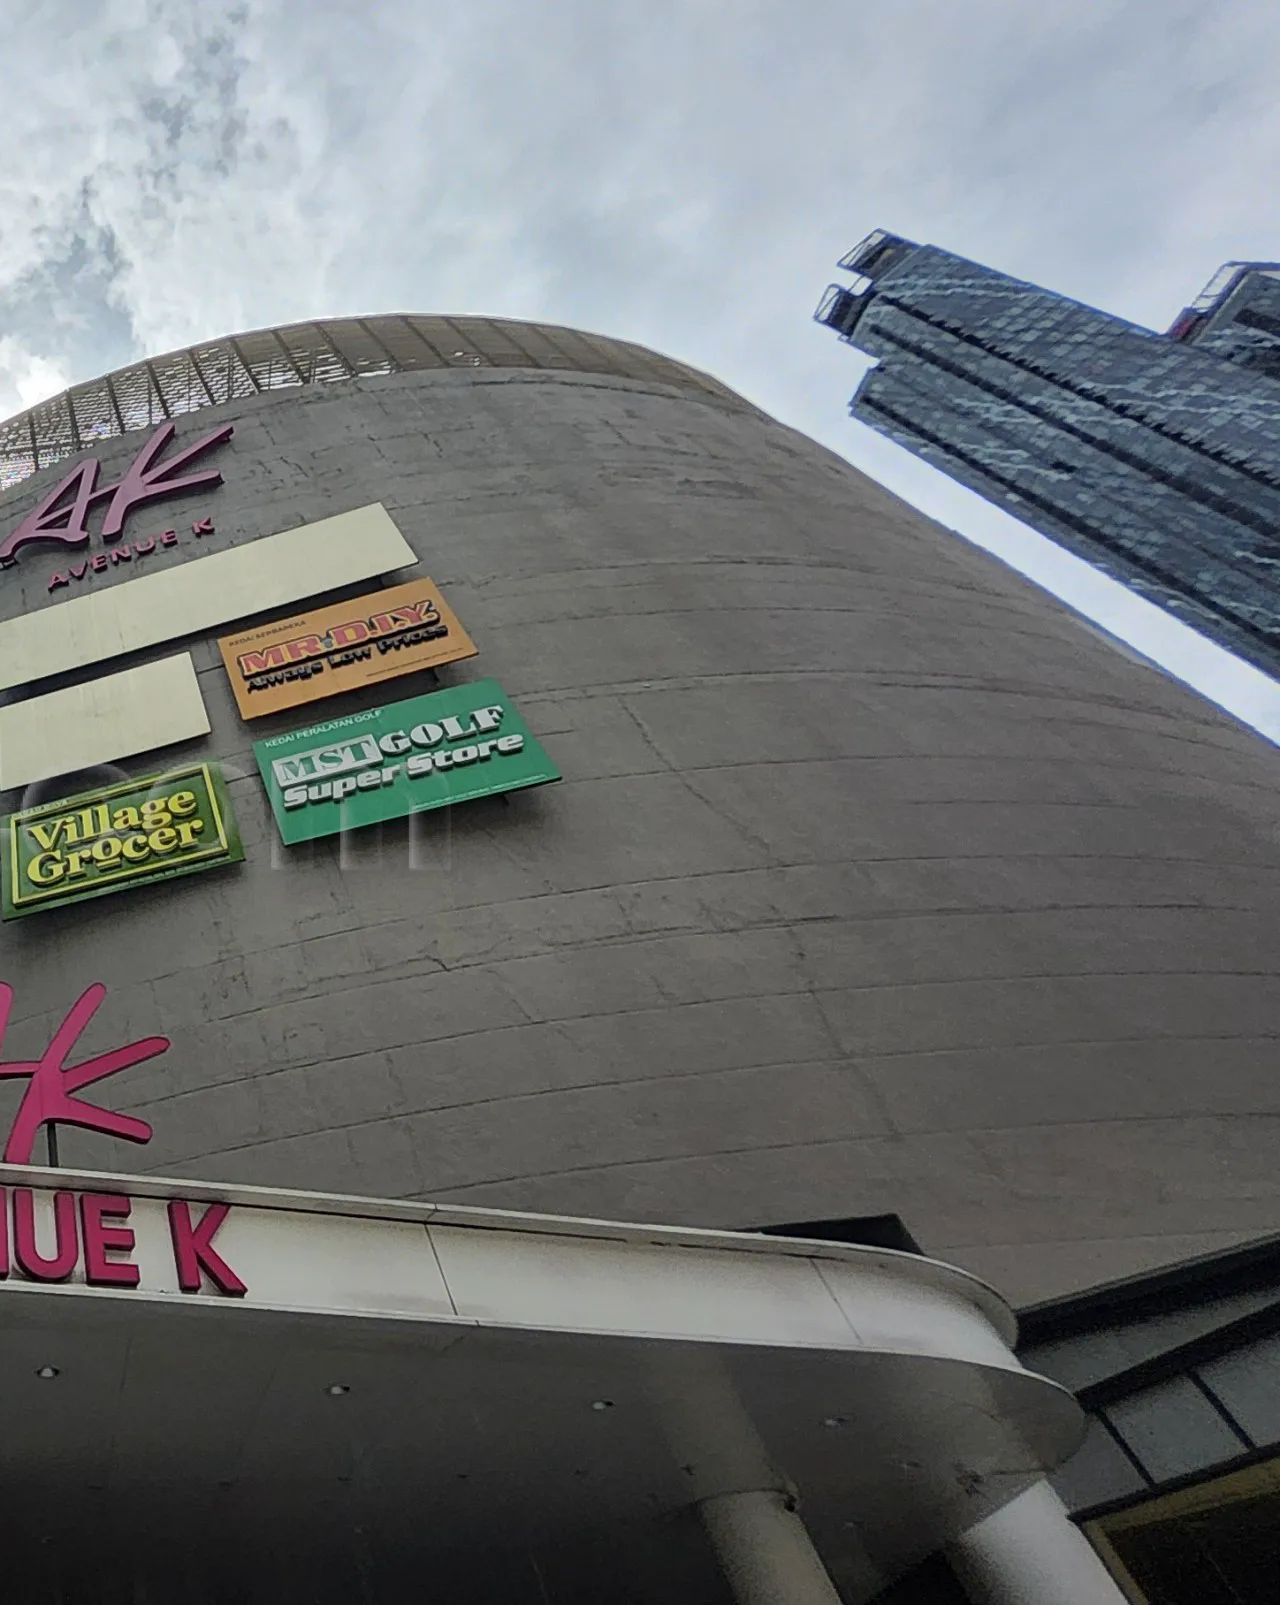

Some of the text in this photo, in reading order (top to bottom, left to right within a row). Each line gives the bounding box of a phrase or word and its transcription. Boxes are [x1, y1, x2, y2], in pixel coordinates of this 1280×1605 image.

[46, 516, 216, 592] AVENUE K
[264, 709, 382, 748] KEDAI PERALATAN GOLF
[378, 705, 504, 756] GOLF
[283, 763, 401, 810] Super
[407, 733, 524, 779] Store
[27, 790, 197, 851] Village
[27, 818, 204, 886] Grocer
[168, 1200, 248, 1298] K
